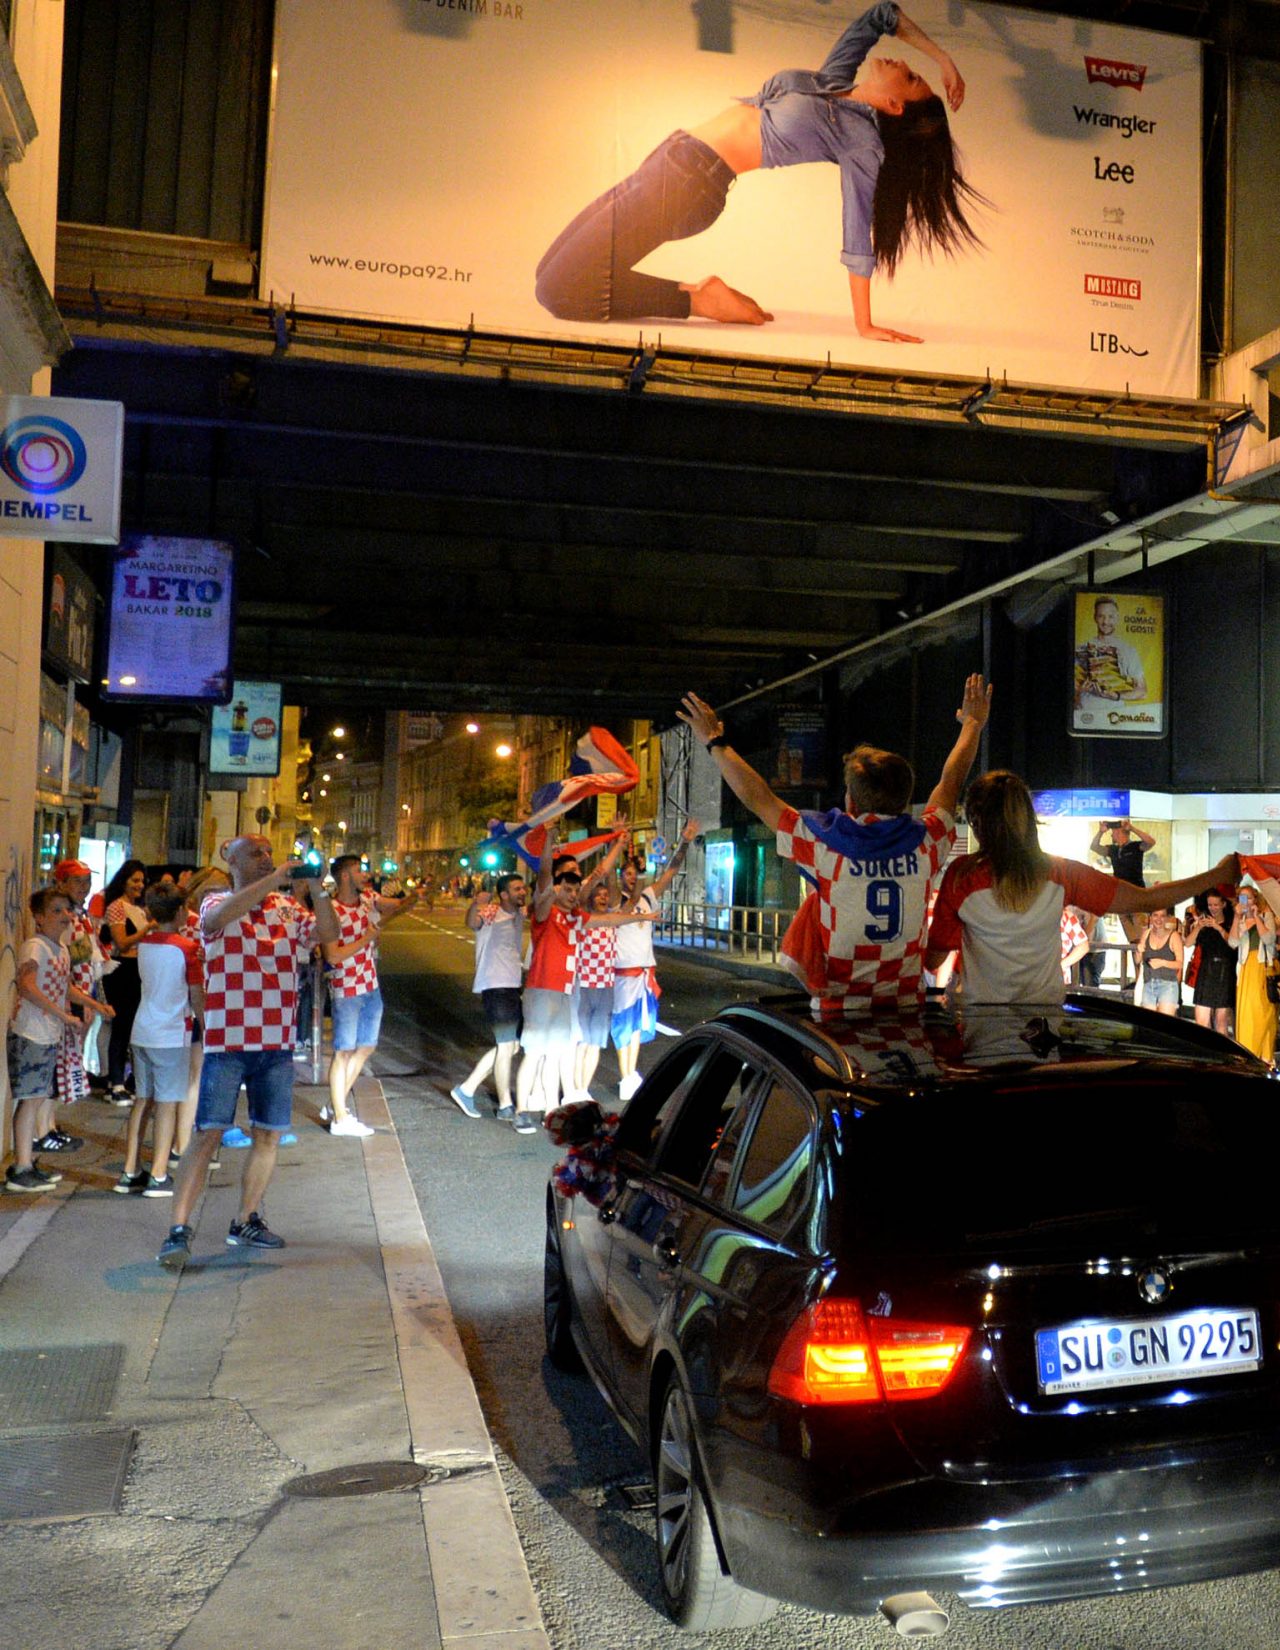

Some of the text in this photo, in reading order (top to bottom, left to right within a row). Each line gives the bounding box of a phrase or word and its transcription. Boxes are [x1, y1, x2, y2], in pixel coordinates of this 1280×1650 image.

[493, 0, 524, 20] BAR
[1073, 104, 1157, 138] Wrangler
[1094, 156, 1134, 183] Lee
[309, 253, 473, 283] www.europa92.hr
[1087, 276, 1139, 298] MUSTANG
[1090, 331, 1119, 354] LTB
[0, 500, 93, 522] EMPEL
[123, 575, 223, 604] LETO
[127, 604, 213, 619] BAKAR 2018
[1060, 796, 1121, 811] alpina
[864, 879, 905, 944] 9
[1060, 1316, 1255, 1374] SU GN 9295
[1046, 1363, 1055, 1374] D
